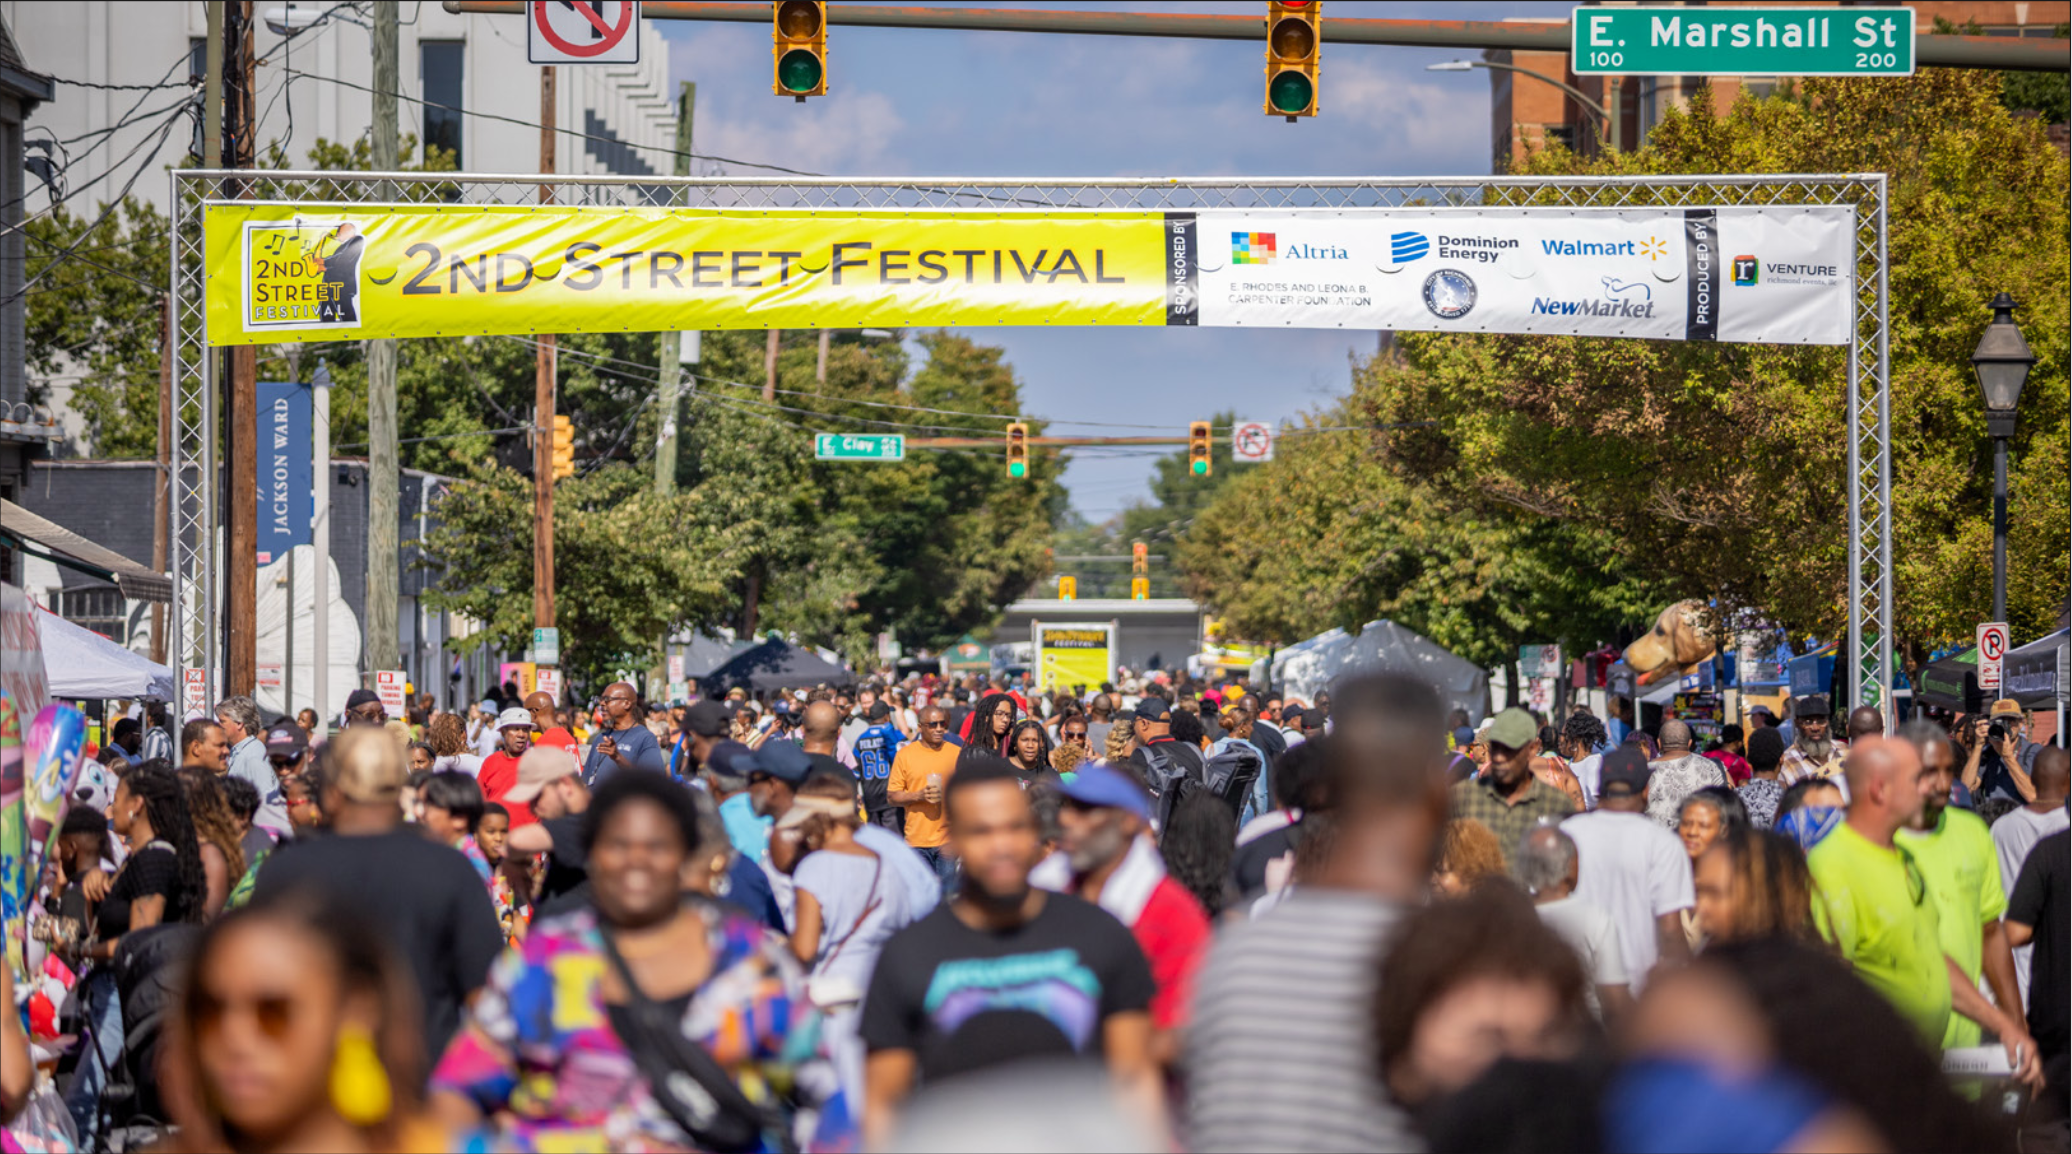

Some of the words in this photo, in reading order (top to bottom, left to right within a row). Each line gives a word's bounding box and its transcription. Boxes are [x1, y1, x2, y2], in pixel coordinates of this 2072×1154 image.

[1590, 16, 1625, 47] E.
[1651, 16, 1829, 47] Marshall
[1853, 16, 1897, 48] St
[1590, 52, 1623, 67] 100
[1855, 53, 1897, 68] 200
[1173, 221, 1186, 234] BY
[1695, 222, 1708, 239] BY
[1438, 235, 1520, 249] Dominion
[1541, 239, 1636, 256] Walmart
[1285, 243, 1349, 260] Altria
[1439, 247, 1499, 263] Energy
[256, 259, 304, 279] 2ND
[402, 242, 535, 296] 2ND
[562, 241, 802, 291] STREET
[831, 241, 1126, 286] FESTIVAL
[1174, 236, 1187, 315] SPONSORED
[1766, 263, 1837, 277] VENTURE
[1242, 282, 1288, 292] RHODES
[1291, 283, 1315, 293] AND
[1318, 284, 1356, 293] LEONA
[1359, 285, 1369, 294] B.
[1696, 244, 1710, 325] PRODUCED
[1766, 276, 1800, 285] richmond
[256, 282, 344, 303] STREET
[1228, 294, 1294, 305] CARPENTER
[1297, 295, 1371, 306] FOUNDATION
[255, 304, 346, 320] FESTIVAL
[1531, 297, 1655, 319] NewMarket
[274, 398, 289, 450] WARD
[842, 436, 875, 453] Clay
[274, 454, 291, 536] JACKSON
[861, 749, 890, 780] 66
